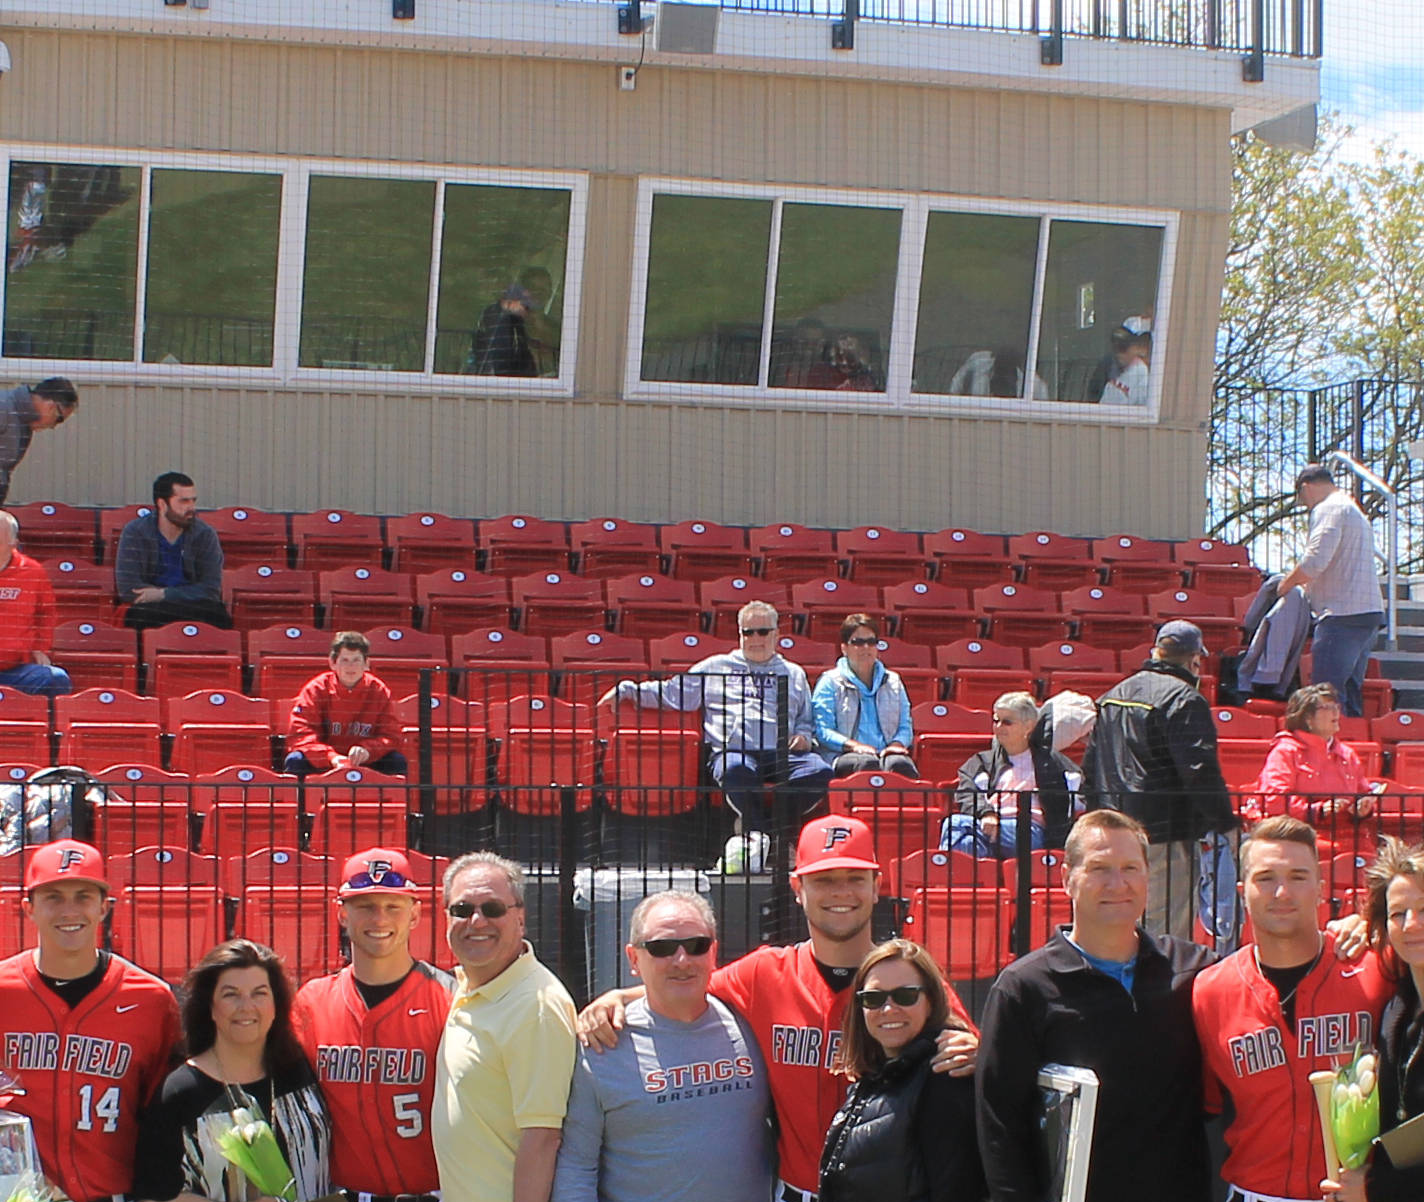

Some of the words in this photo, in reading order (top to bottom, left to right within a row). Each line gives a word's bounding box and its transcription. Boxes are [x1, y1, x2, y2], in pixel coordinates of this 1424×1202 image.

[644, 1056, 754, 1093] STAGS
[656, 1080, 753, 1105] BASEBALL
[76, 1084, 121, 1132] 14
[392, 1092, 423, 1138] 5
